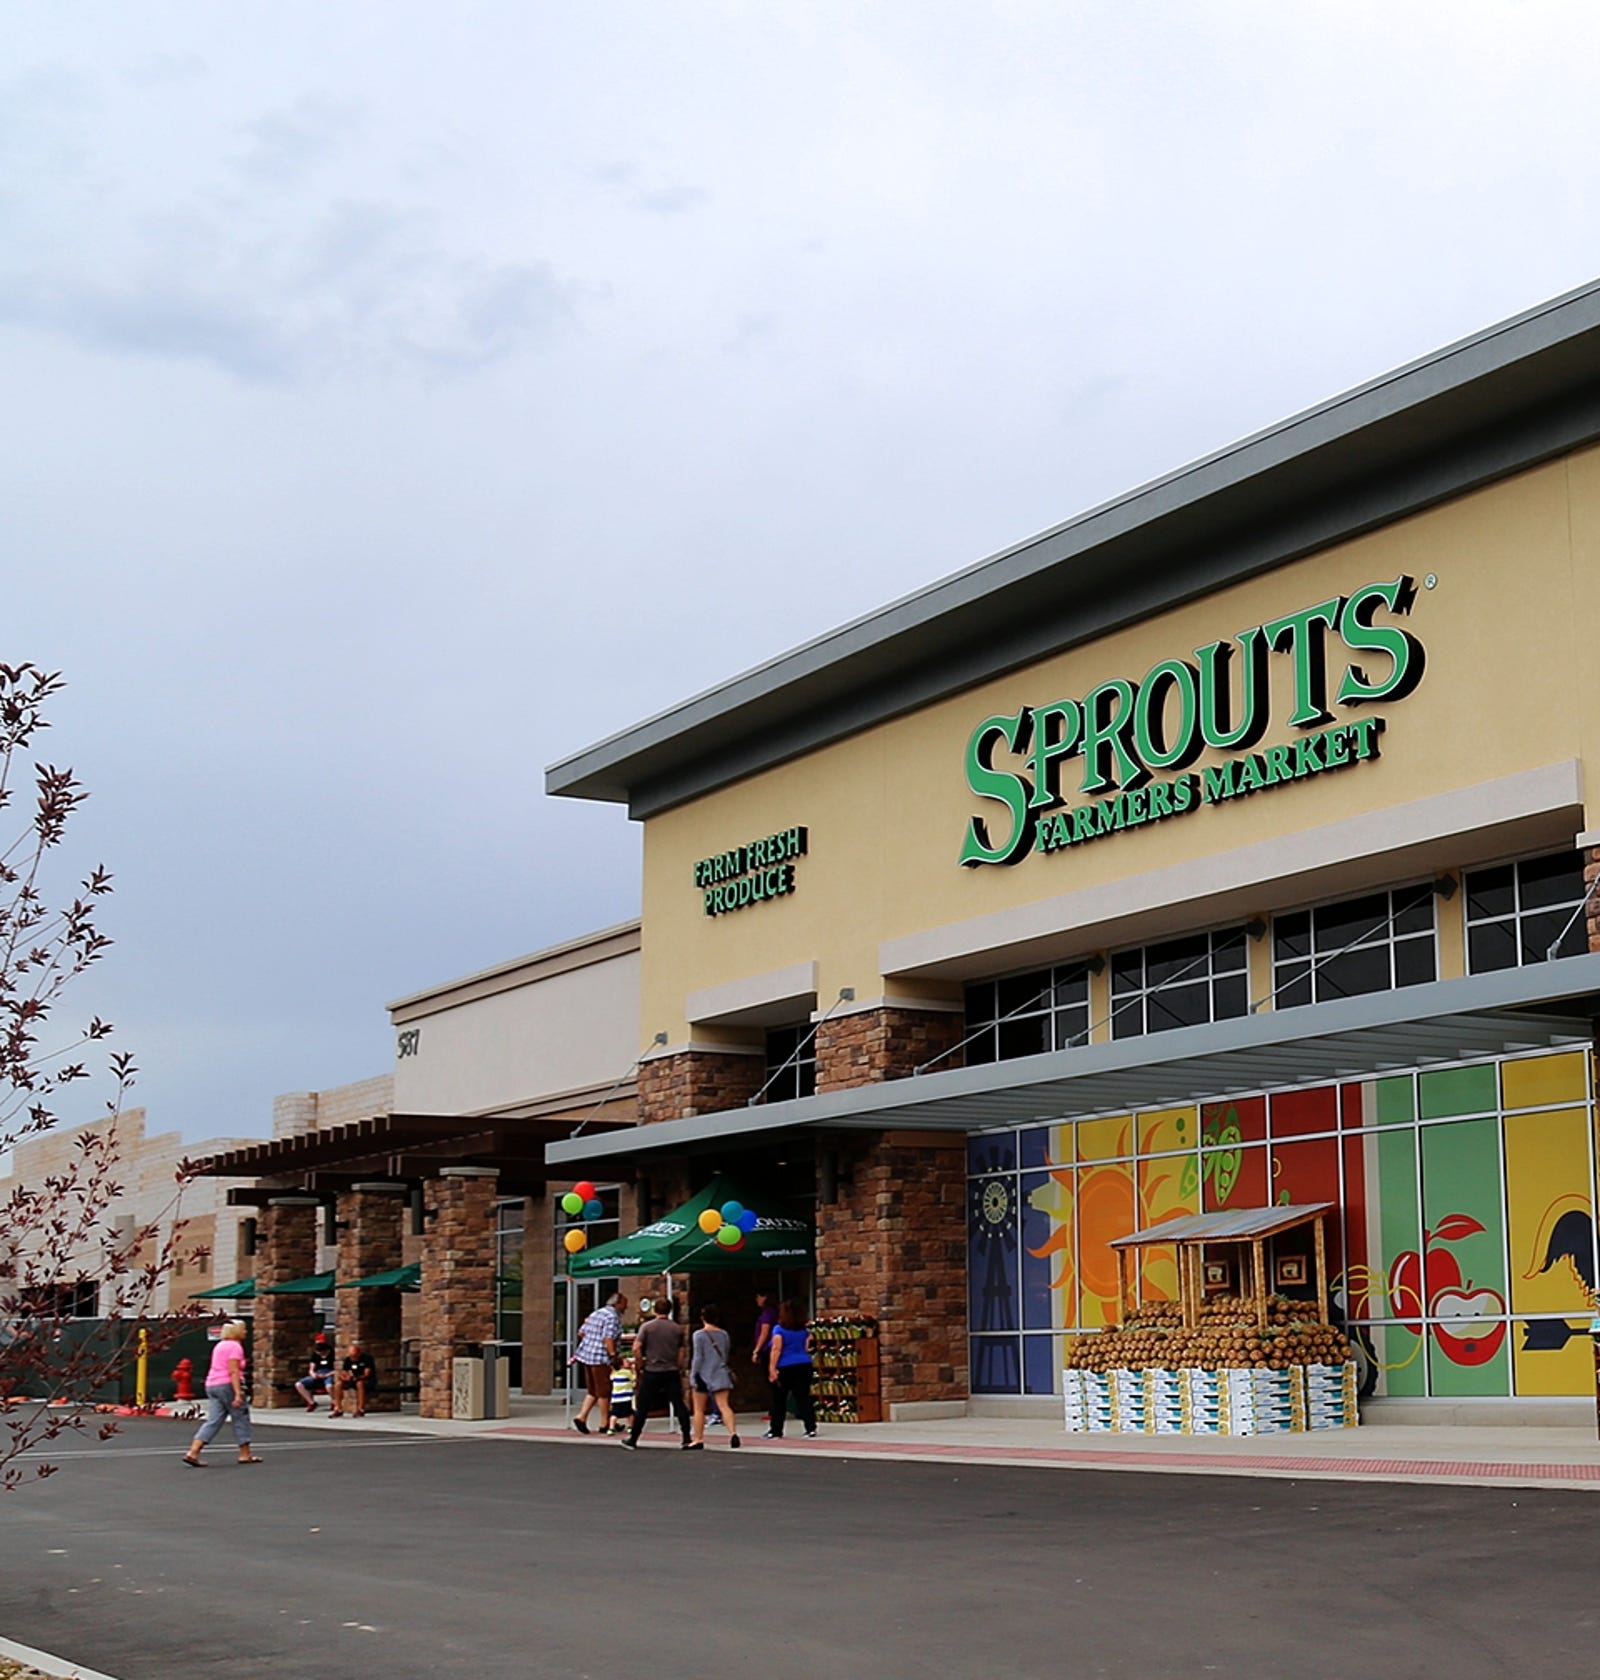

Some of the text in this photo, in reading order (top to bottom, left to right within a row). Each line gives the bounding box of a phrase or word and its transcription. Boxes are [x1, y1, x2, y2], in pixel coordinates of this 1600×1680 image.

[959, 574, 1425, 868] SPROUTS
[1034, 715, 1386, 855] FARMERS MARKET
[693, 825, 808, 889] FARM FRESH
[703, 863, 796, 917] PRODUCE
